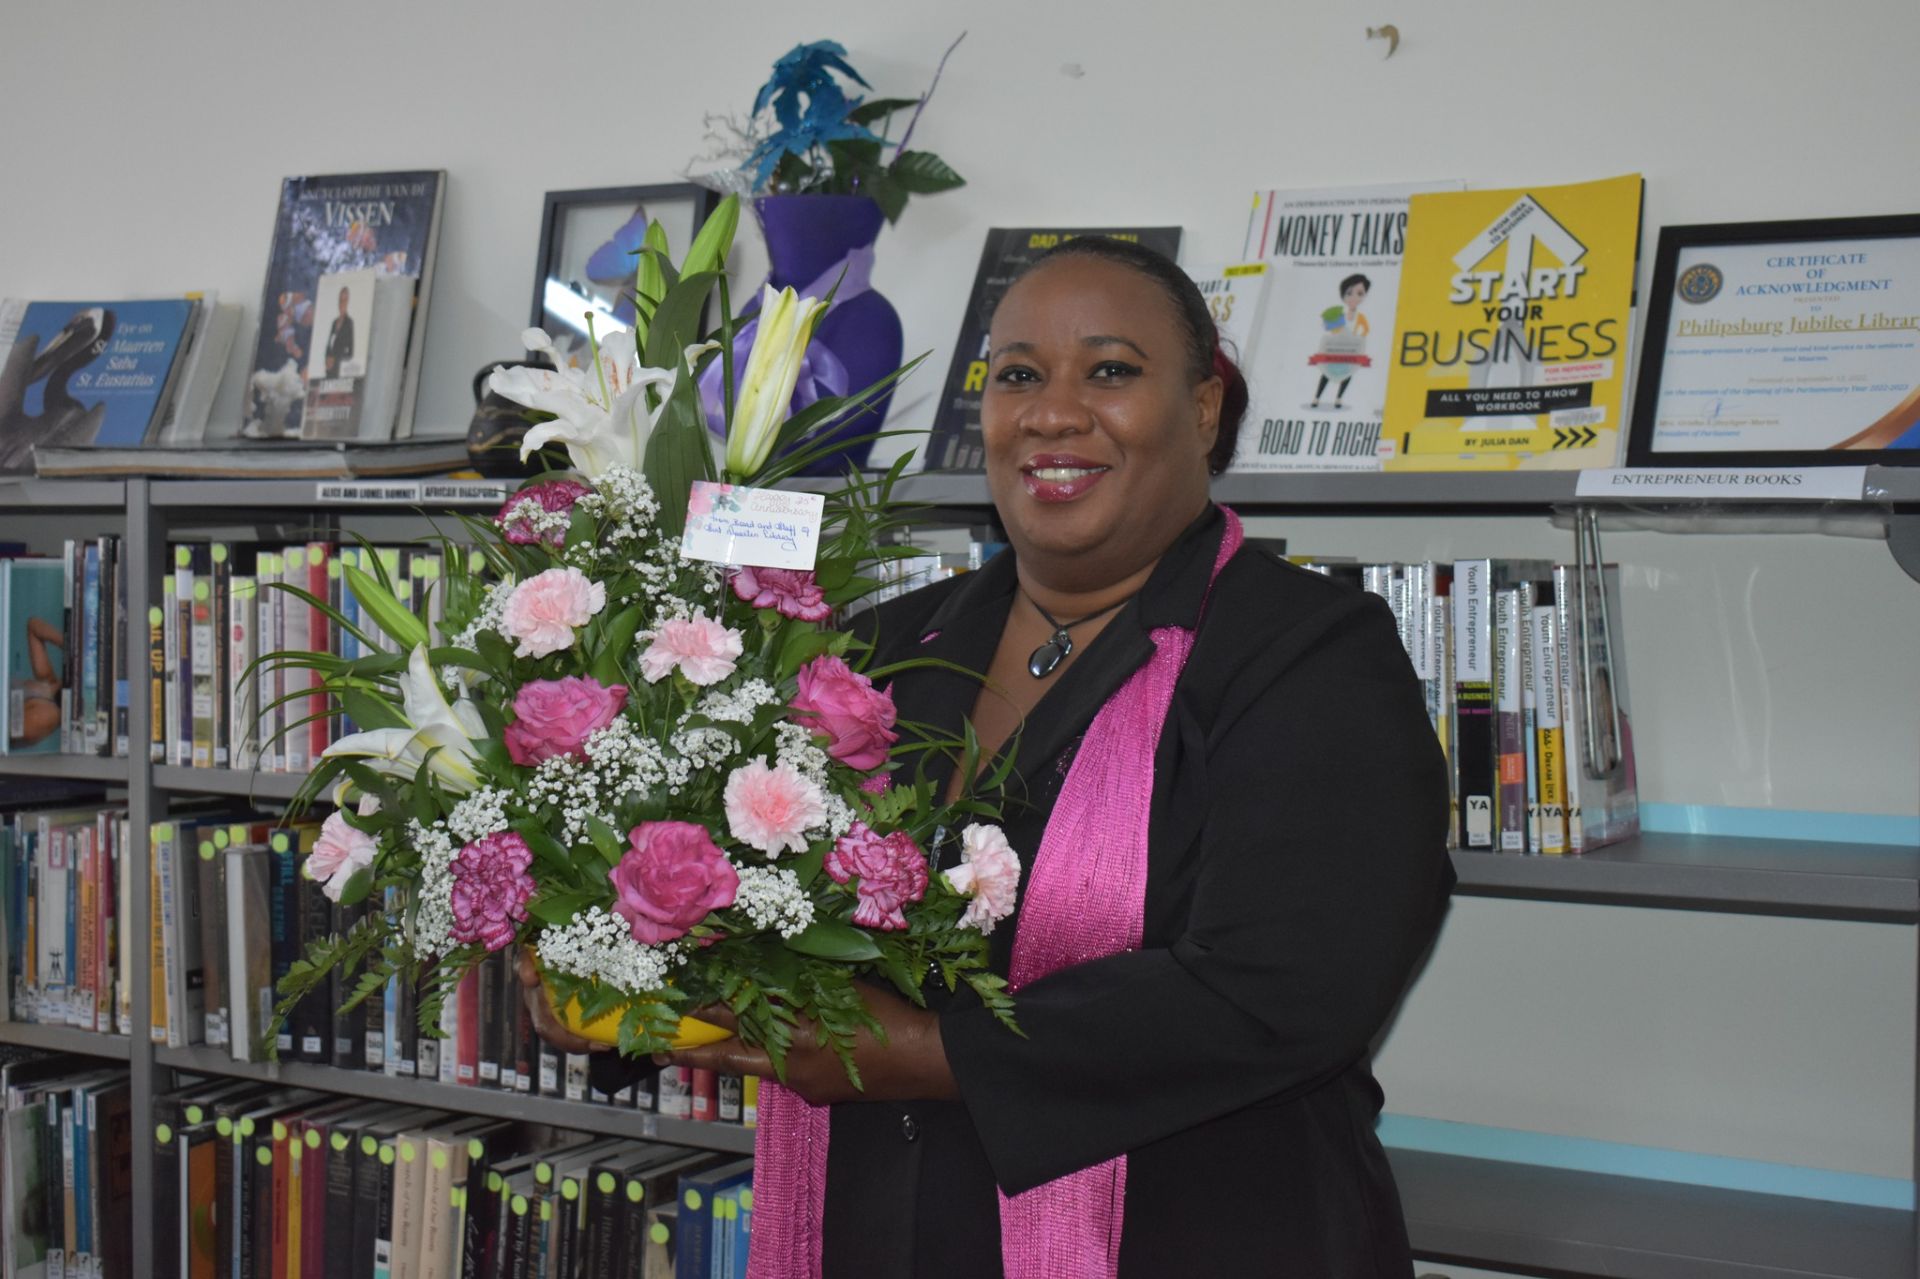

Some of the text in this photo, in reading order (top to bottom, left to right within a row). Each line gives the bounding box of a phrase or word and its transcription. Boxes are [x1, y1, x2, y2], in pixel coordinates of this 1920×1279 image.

[325, 201, 395, 227] VISSEN
[1501, 205, 1535, 237] BUSINESS
[1274, 211, 1409, 257] MONEY TALKS
[1766, 252, 1867, 269] CERTIFICATE
[1806, 269, 1826, 281] OF
[1196, 280, 1223, 293] TART
[1449, 264, 1585, 306] START
[1736, 280, 1892, 298] ACKNOWLEDGMENT
[1483, 304, 1544, 325] YOUR
[1676, 316, 1783, 340] Philipsburg
[1787, 313, 1853, 336] Jubilee
[111, 338, 165, 355] Maarten
[1399, 318, 1618, 371] BUSINESS
[106, 356, 138, 373] Saba
[95, 372, 156, 390] Eustatius
[1440, 387, 1579, 405] ALL YOU NEED TO KNOW
[1475, 400, 1541, 415] WORKBOOK
[1258, 419, 1304, 456] ROAD
[1307, 420, 1331, 457] TO
[1464, 435, 1530, 449] BY JULIA DAN
[1612, 473, 1803, 489] ENTREPRENEUR BOOKS
[343, 488, 358, 499] AND
[424, 486, 499, 499] AFRICAN DIASPORA
[88, 607, 98, 635] Wind
[1466, 565, 1479, 674] Youth Entrepreneur
[151, 623, 163, 645] AIL
[1496, 595, 1508, 702] Youth Entrepreneur
[1522, 618, 1534, 692] Entrepreneur
[1560, 613, 1573, 688] Entrepreneur
[151, 648, 164, 673] UP
[1539, 614, 1556, 720] Youth Entrepreneur
[1469, 799, 1489, 811] YA
[1543, 807, 1563, 818] YA
[368, 1038, 383, 1049] bio
[720, 1078, 739, 1090] YA
[723, 1095, 738, 1106] bio
